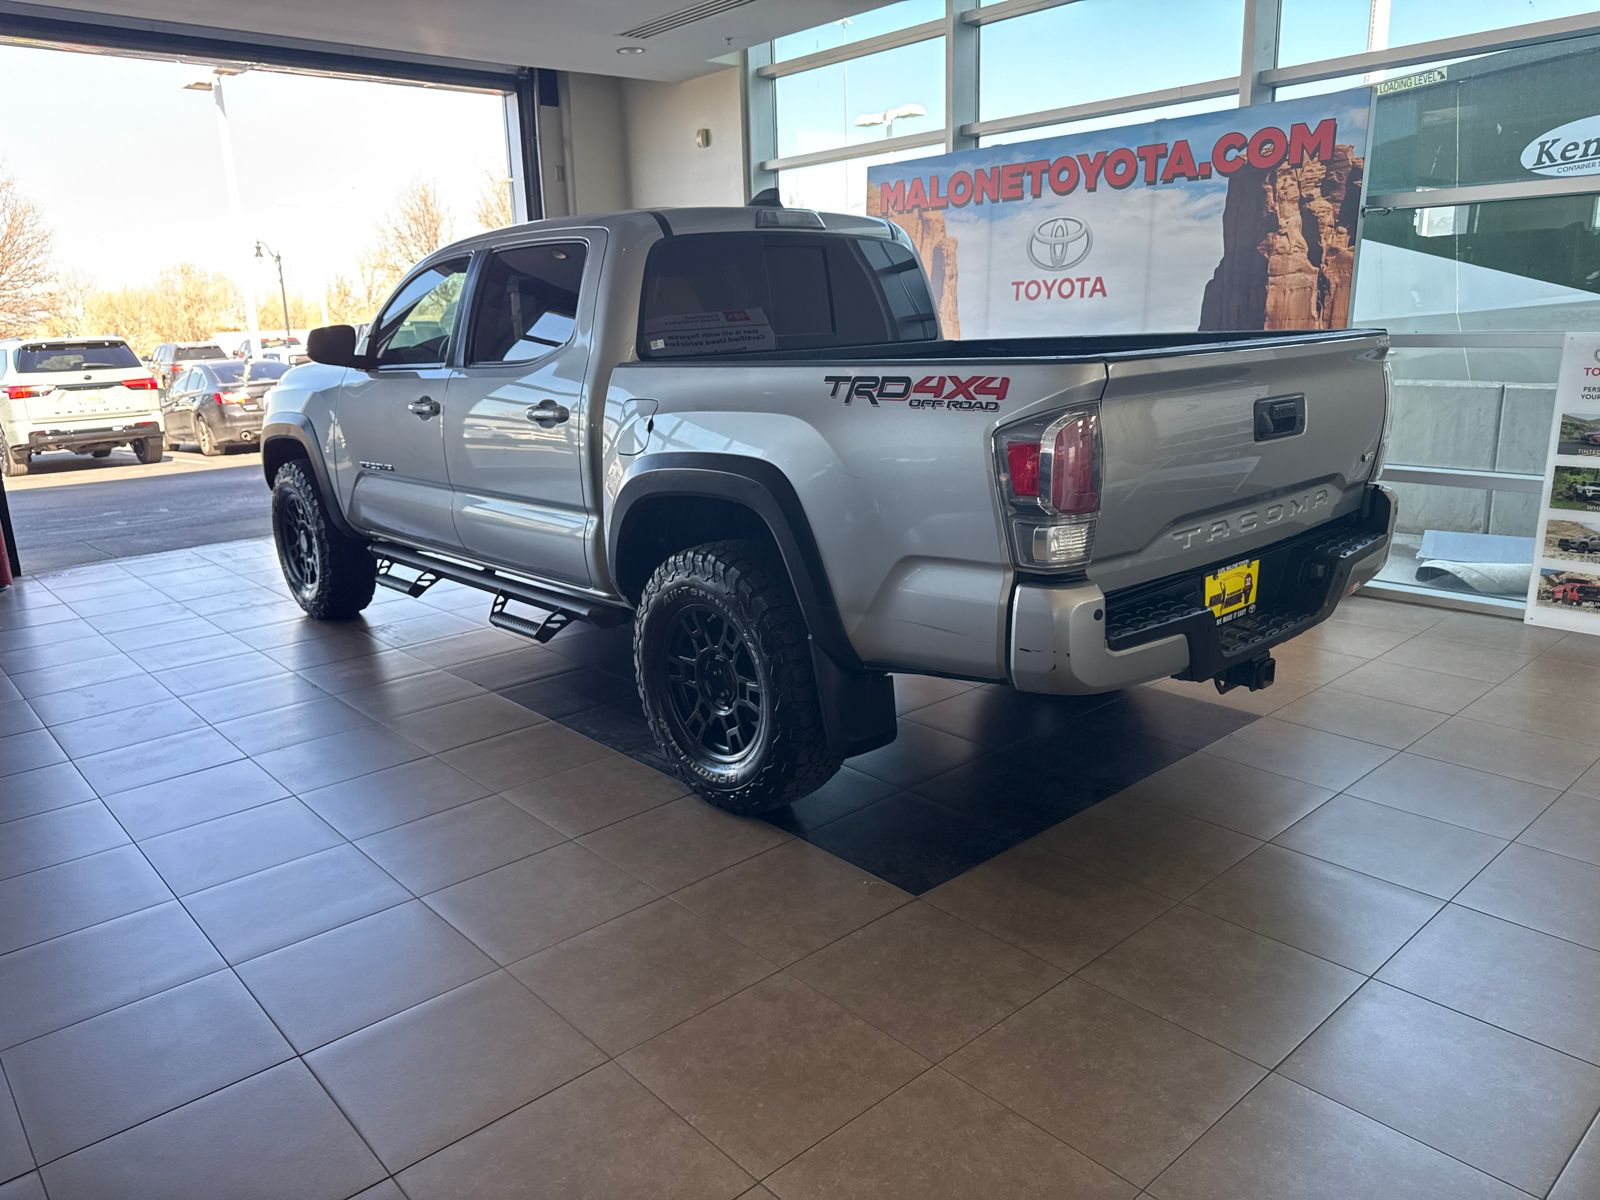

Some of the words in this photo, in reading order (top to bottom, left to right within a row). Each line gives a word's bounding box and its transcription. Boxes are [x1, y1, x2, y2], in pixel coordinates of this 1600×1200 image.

[1379, 79, 1413, 94] LOADING
[1414, 72, 1437, 86] LEVEL
[880, 117, 1338, 214] MALONETOYOTA.COM
[1556, 161, 1597, 174] CONTAINER
[1011, 276, 1107, 302] TOYOTA
[824, 375, 913, 407] TRD
[912, 375, 1010, 401] 4X4
[908, 398, 945, 410] OFF
[946, 400, 1000, 412] ROAD
[1172, 489, 1329, 549] TACOMA
